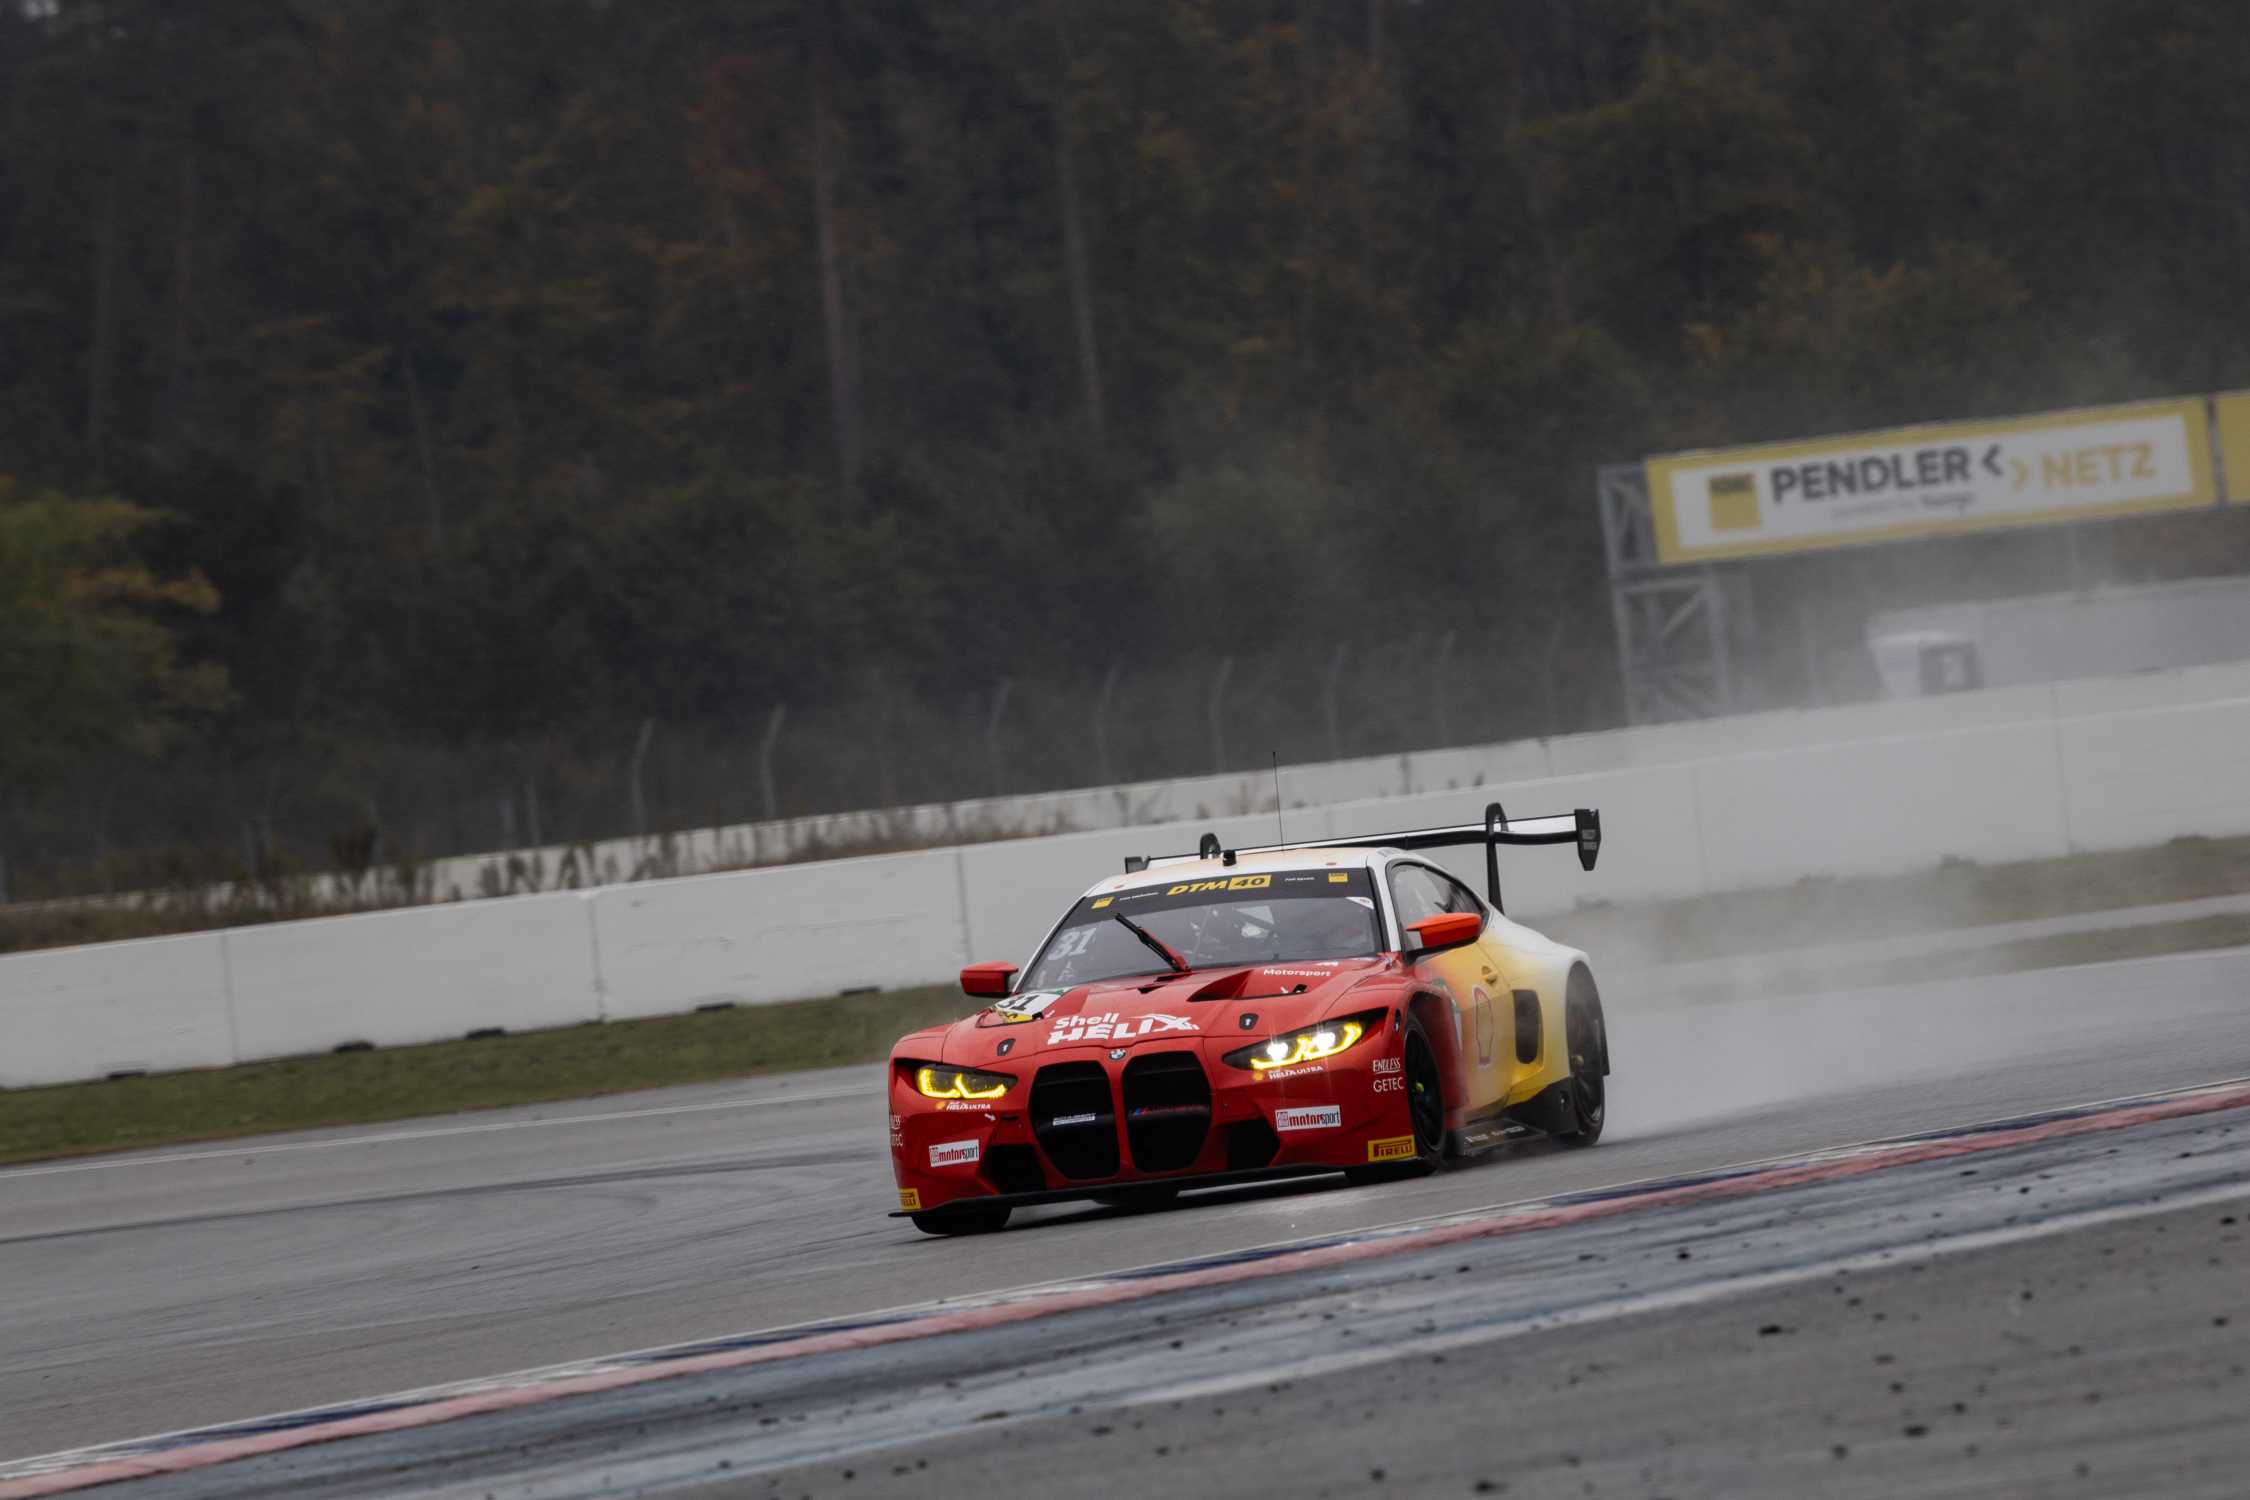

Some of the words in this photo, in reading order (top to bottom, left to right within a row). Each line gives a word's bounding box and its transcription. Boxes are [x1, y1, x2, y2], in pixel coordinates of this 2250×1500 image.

[1769, 446, 1971, 506] PENDLER
[2041, 443, 2157, 487] NETZ
[1167, 880, 1228, 896] DTM
[1234, 876, 1266, 887] 40
[1263, 968, 1331, 977] Motorsport
[1047, 1013, 1200, 1045] HELIX
[1053, 1012, 1120, 1030] Shell
[1372, 1057, 1401, 1073] ENDLESS
[1372, 1077, 1404, 1093] GETEC
[1288, 1111, 1340, 1128] motorsport
[939, 1145, 978, 1163] motorsport
[1373, 1139, 1413, 1158] PIRELLI
